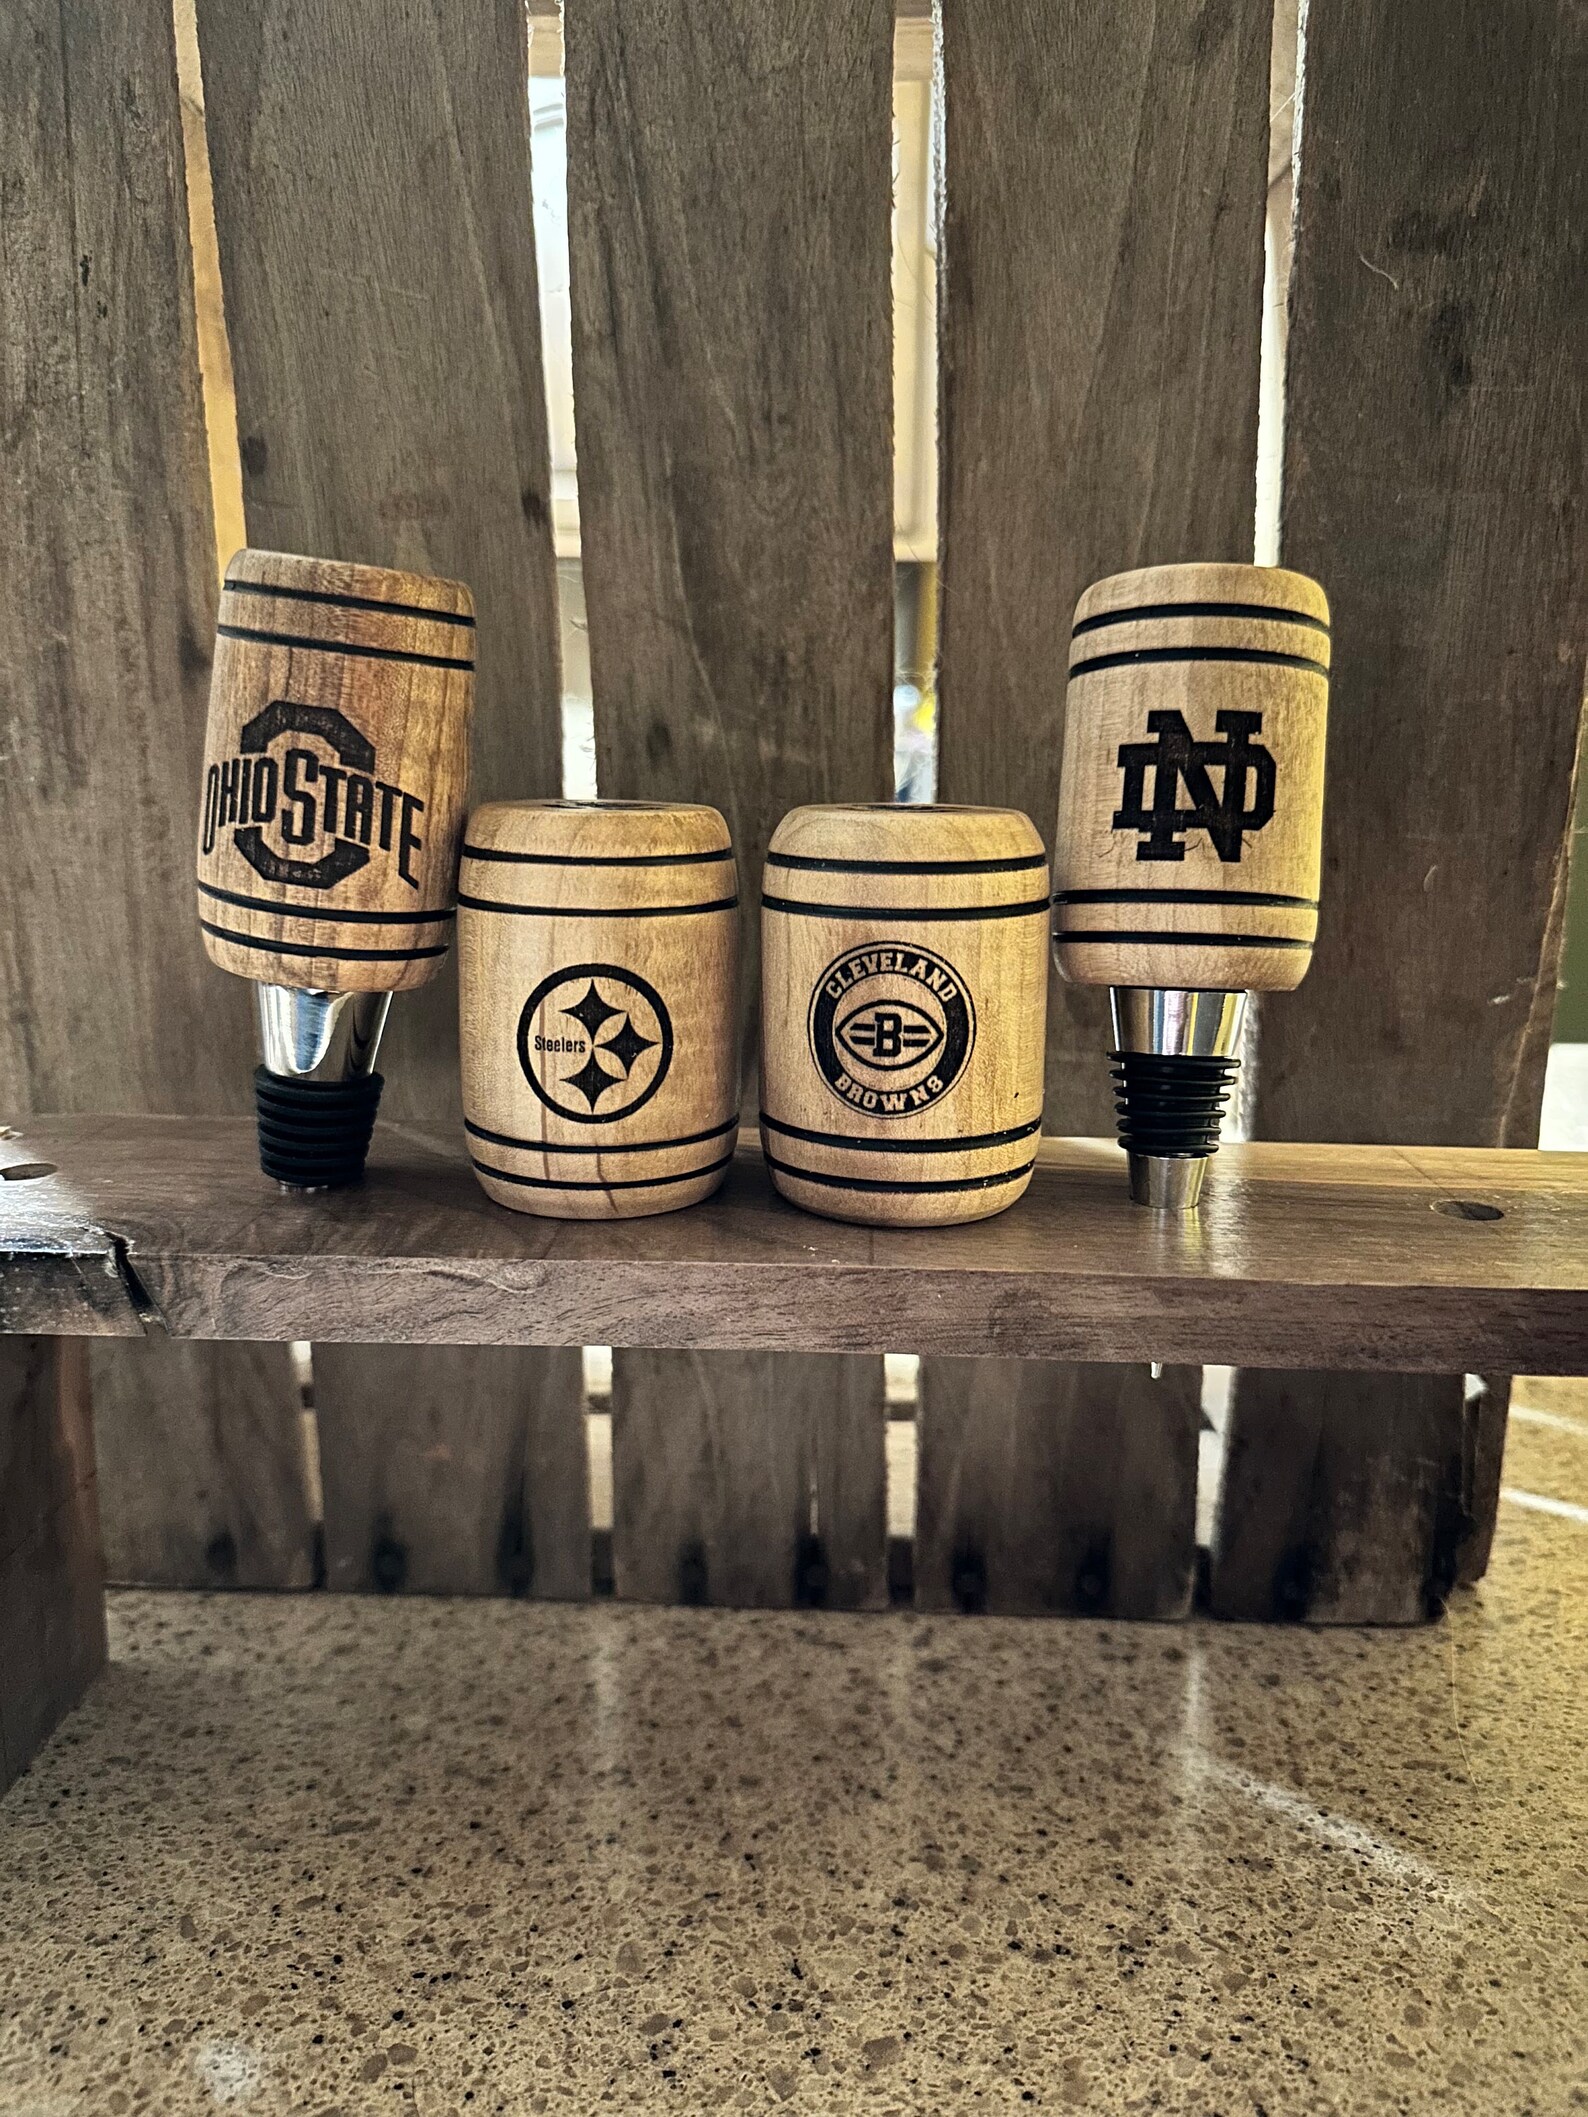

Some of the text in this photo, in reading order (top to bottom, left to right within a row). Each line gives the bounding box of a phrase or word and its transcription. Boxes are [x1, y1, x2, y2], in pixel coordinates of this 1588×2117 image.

[203, 747, 425, 890] OHIO STATE
[825, 951, 958, 1002] CLEVELAND
[534, 1035, 586, 1053] Steelers
[872, 1012, 902, 1057] B
[834, 1073, 944, 1112] BROWNS
